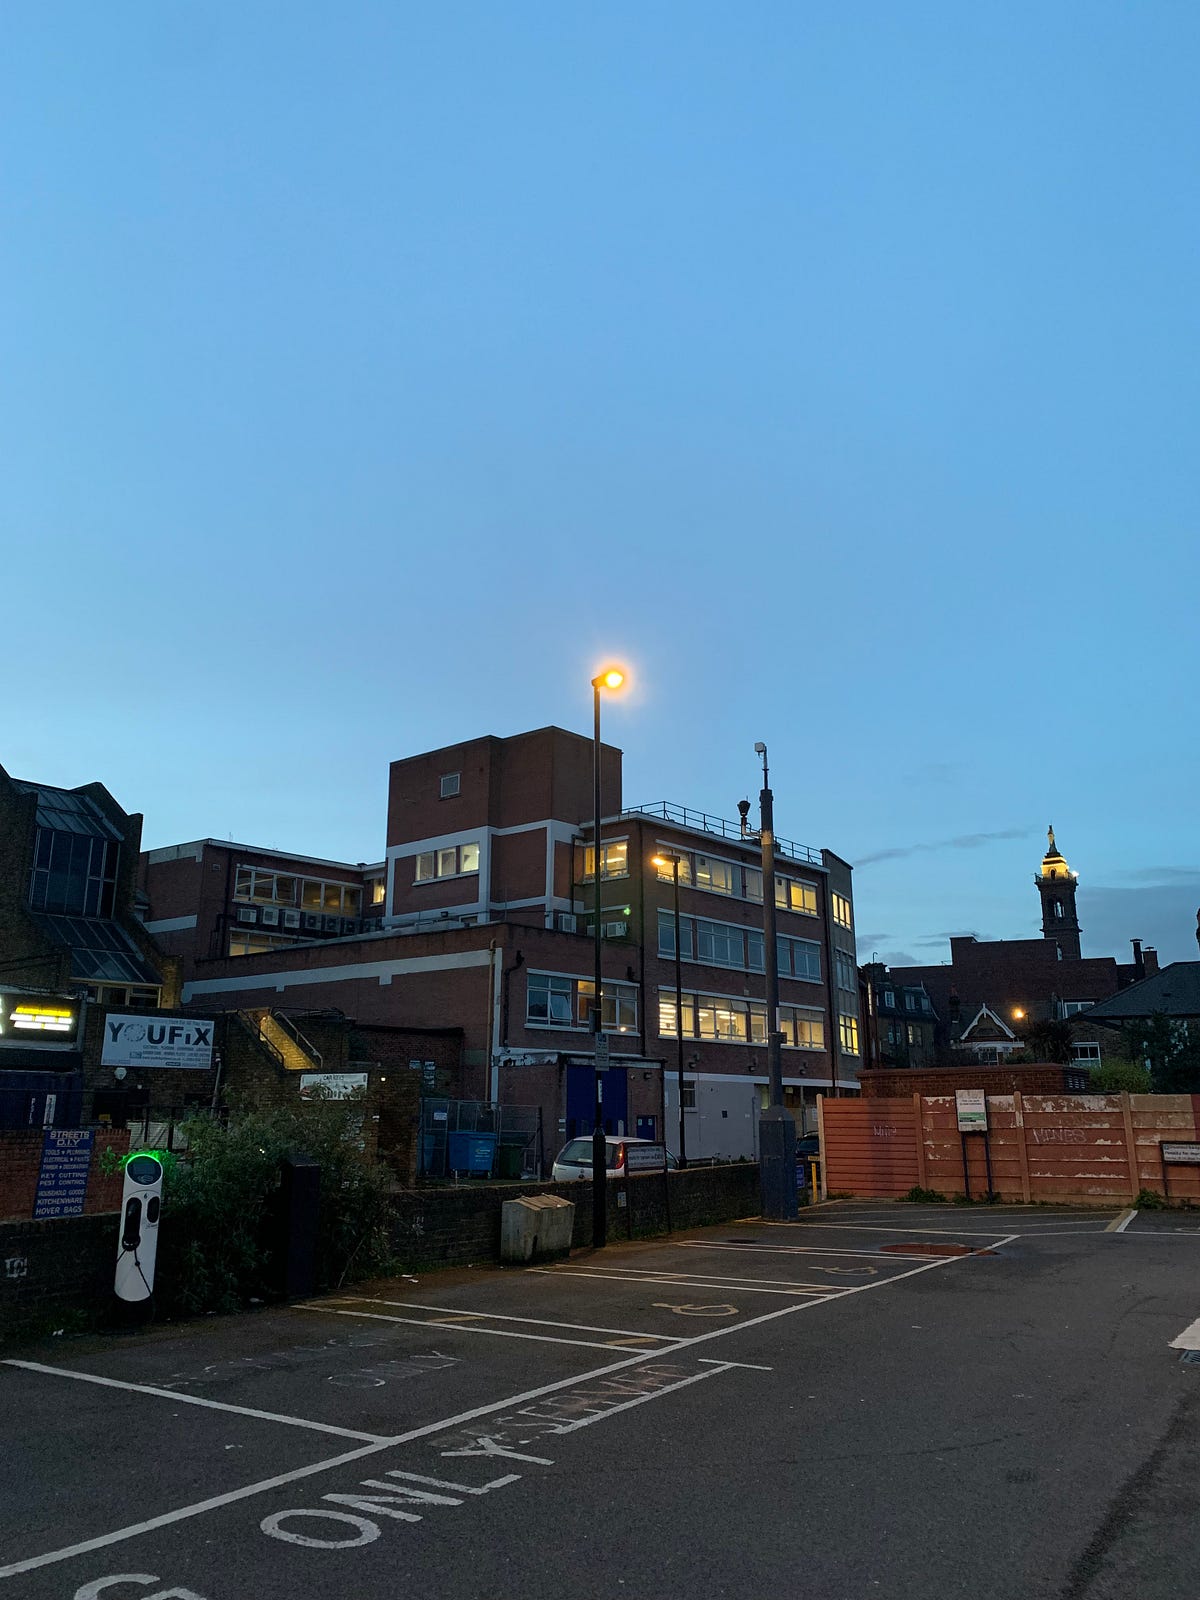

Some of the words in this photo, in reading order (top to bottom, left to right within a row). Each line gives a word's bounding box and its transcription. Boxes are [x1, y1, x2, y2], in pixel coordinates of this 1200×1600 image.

[50, 1130, 89, 1139] STREETS
[38, 1189, 67, 1197] HOUSEHOLD
[37, 1197, 83, 1205] KITCHENWARE
[35, 1206, 60, 1215] HOVER
[63, 1205, 82, 1214] BAGS
[260, 1438, 555, 1550] ONLY
